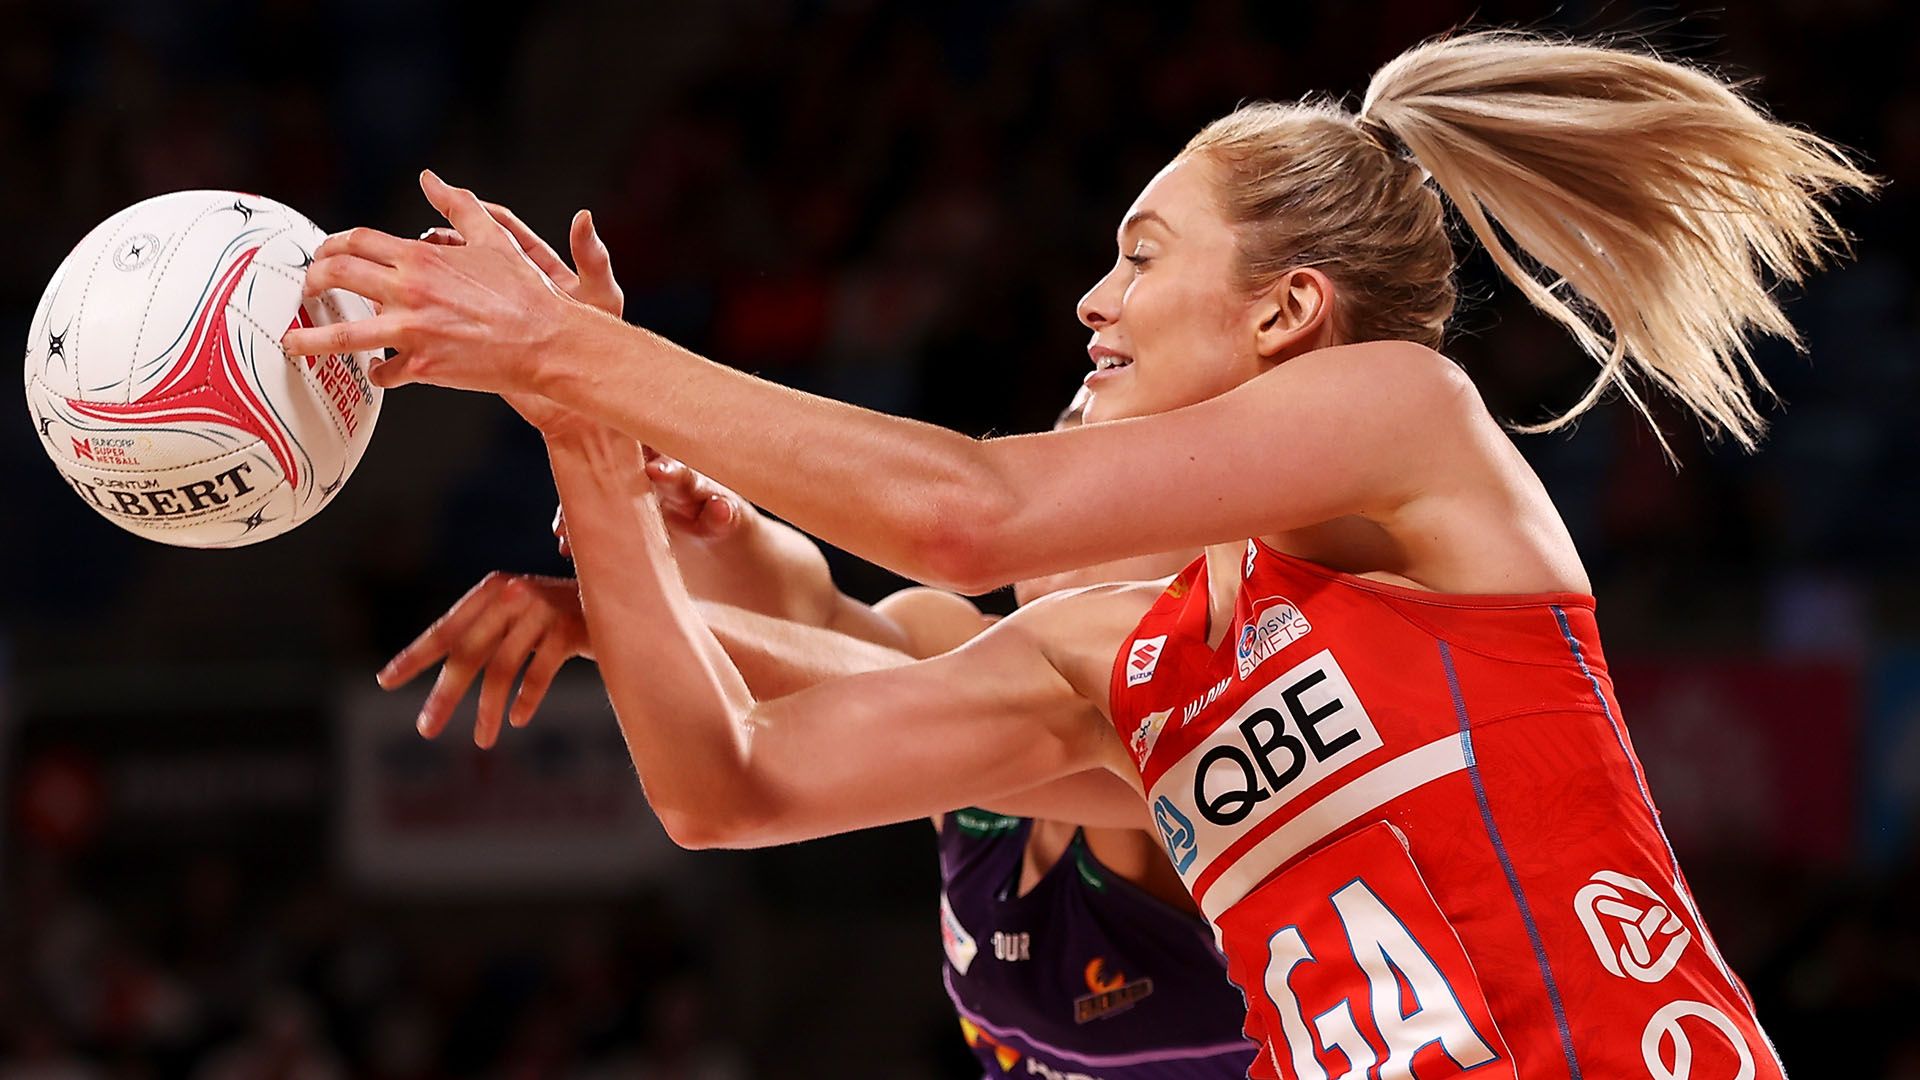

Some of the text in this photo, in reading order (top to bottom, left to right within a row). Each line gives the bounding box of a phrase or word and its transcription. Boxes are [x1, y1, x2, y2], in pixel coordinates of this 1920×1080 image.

[316, 366, 358, 438] NETBALL
[326, 353, 361, 408] SUPER
[338, 352, 374, 406] UNCORP
[94, 447, 125, 457] SUPER
[96, 456, 141, 466] NETBALL
[67, 461, 255, 516] ILBERT
[93, 476, 160, 490] QUANTUM
[1240, 617, 1311, 679] SWIFTS
[1194, 668, 1362, 826] QBE
[1264, 876, 1501, 1080] GA
